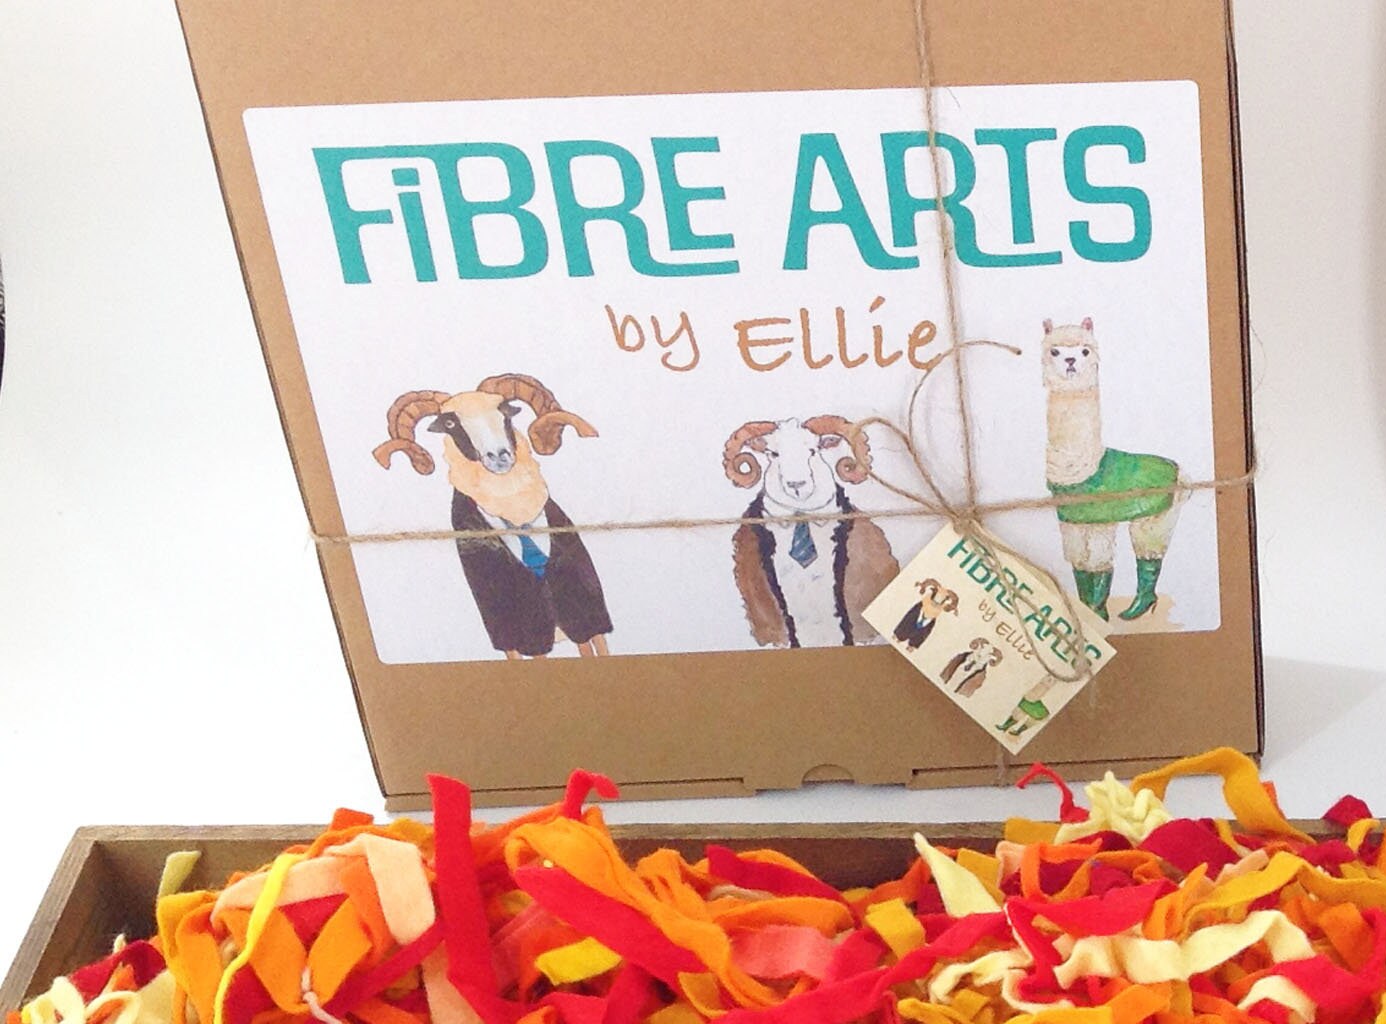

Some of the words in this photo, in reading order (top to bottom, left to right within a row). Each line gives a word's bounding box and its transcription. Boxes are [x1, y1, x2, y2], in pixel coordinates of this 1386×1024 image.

[782, 124, 1153, 271] ARTS
[604, 303, 704, 373] by
[733, 296, 940, 374] Ellie
[1024, 604, 1102, 670] ARS
